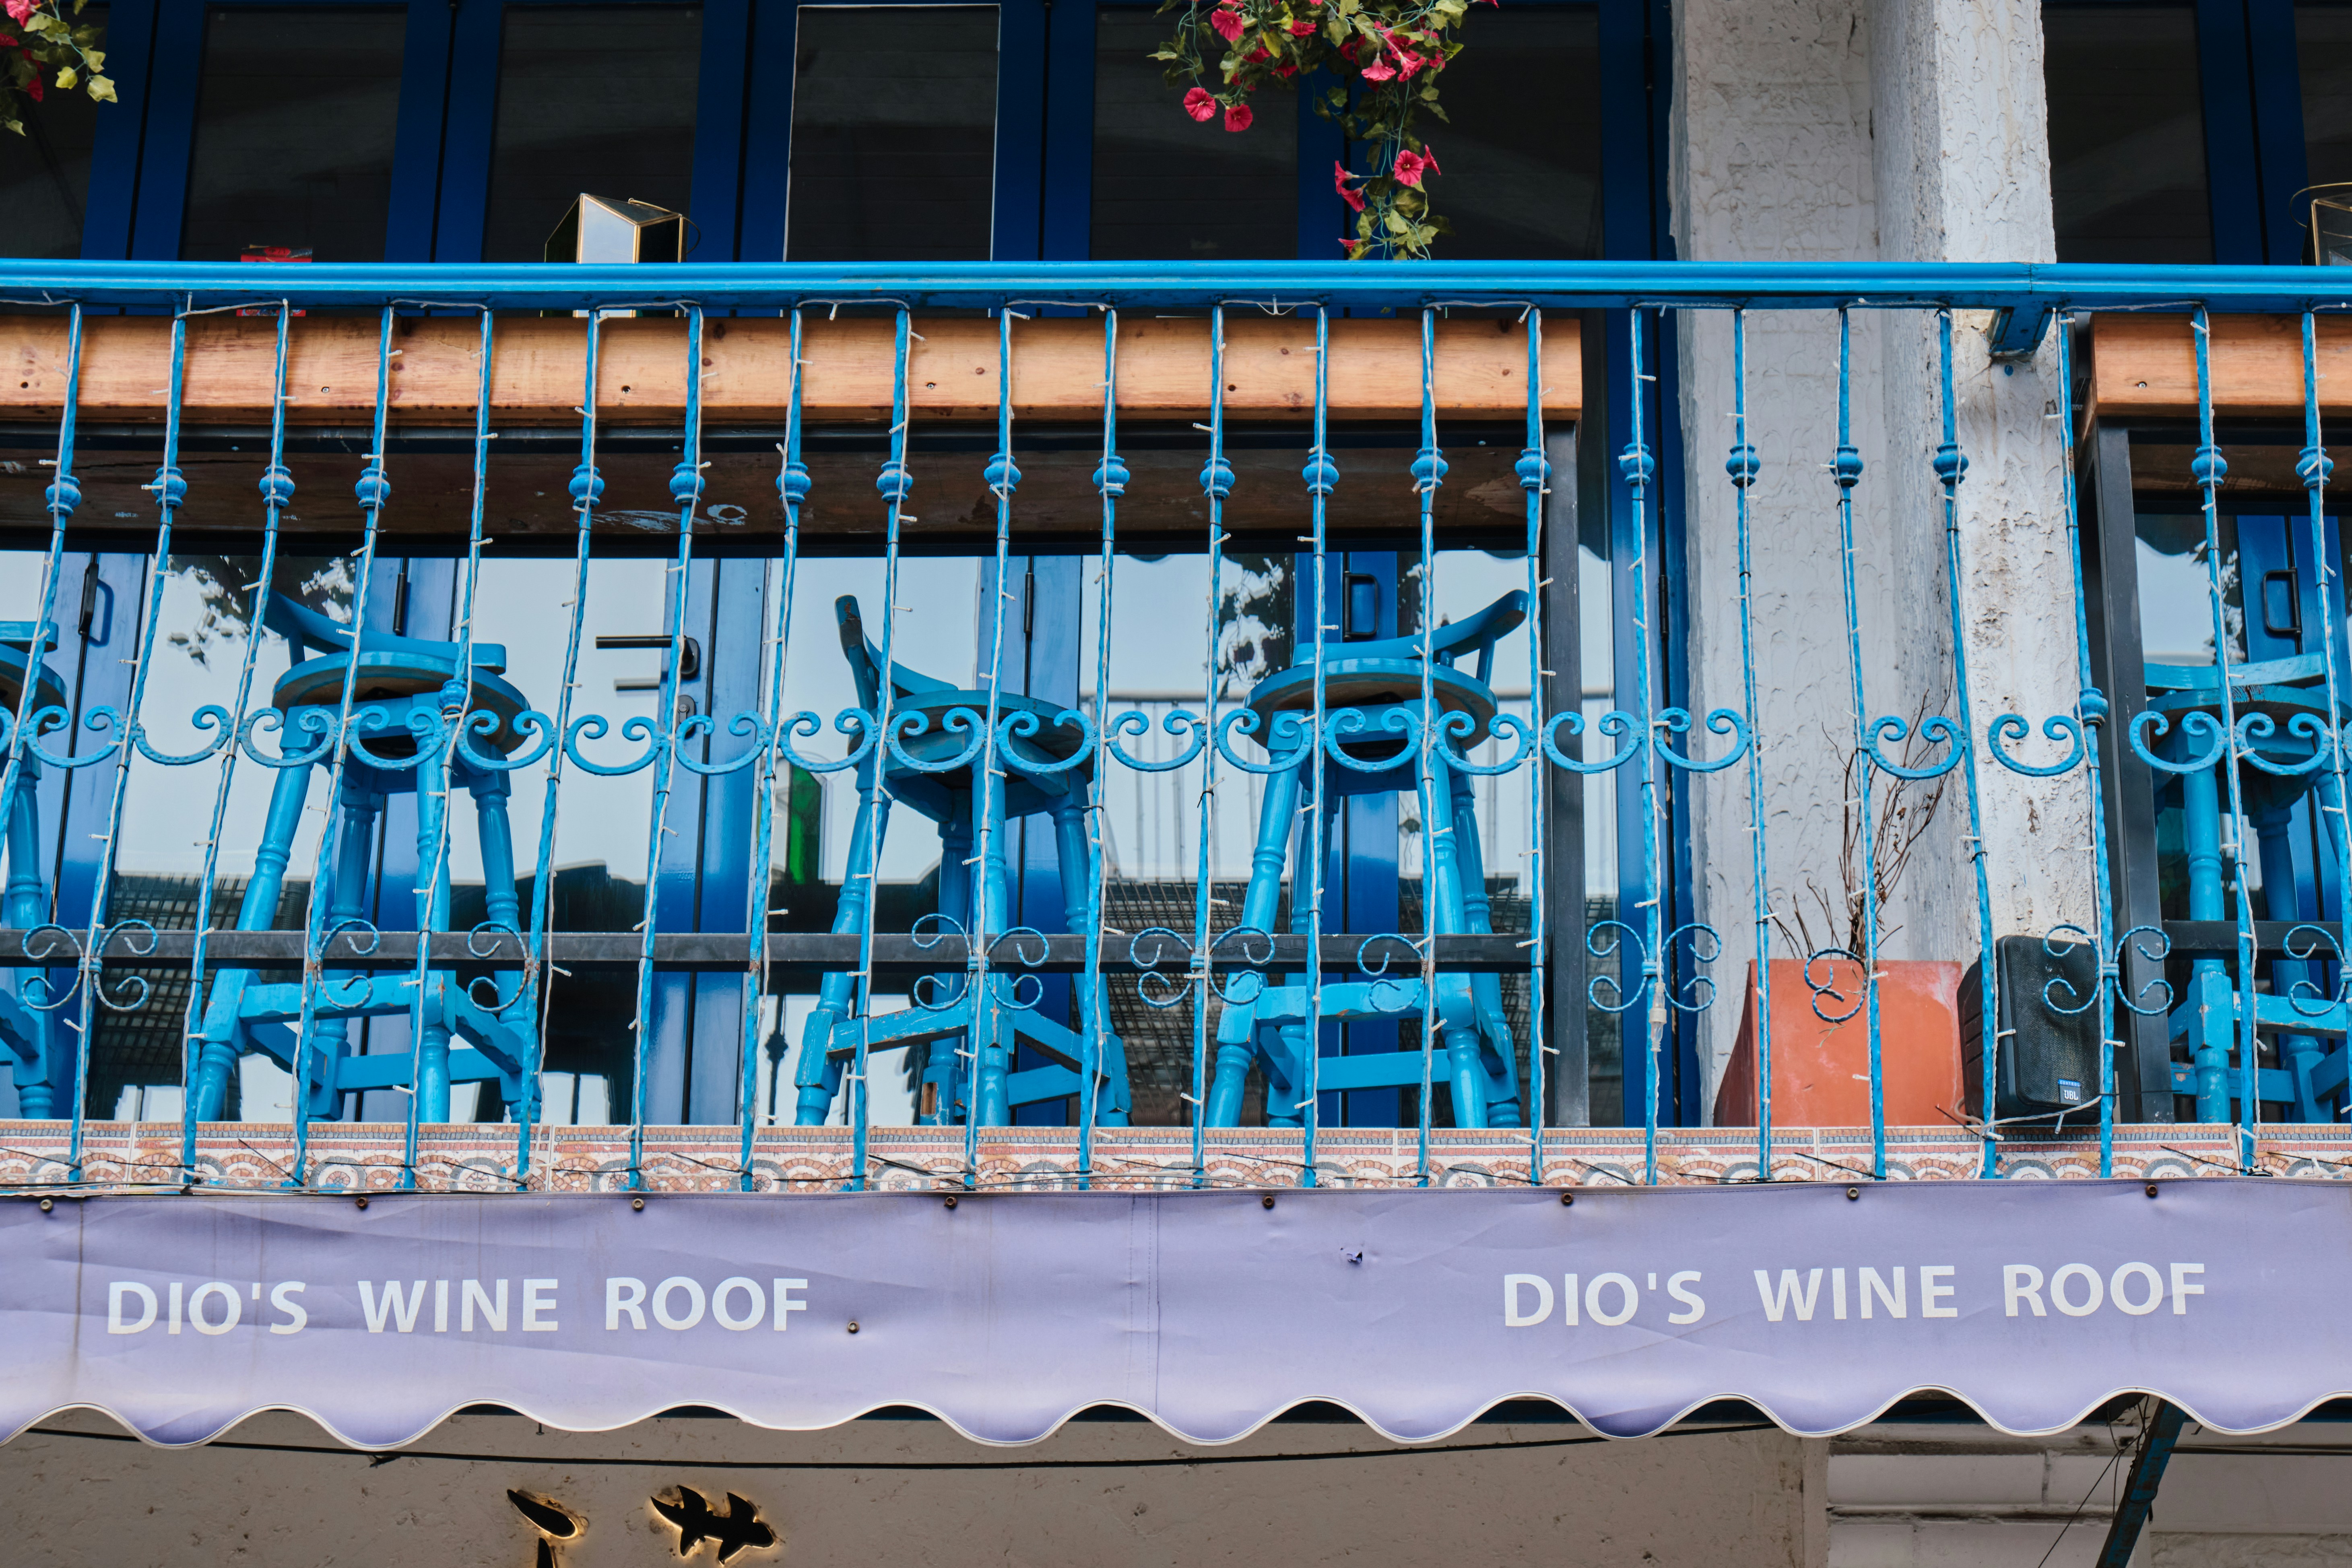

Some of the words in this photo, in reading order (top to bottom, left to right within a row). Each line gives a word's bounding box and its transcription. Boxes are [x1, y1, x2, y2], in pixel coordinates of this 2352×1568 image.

[2064, 1089, 2079, 1100] JBL
[107, 1281, 307, 1335] DIO'S
[357, 1279, 559, 1333] WINE
[605, 1276, 808, 1331] ROOF
[1504, 1270, 1705, 1327] DIO'S
[1754, 1266, 1958, 1322] WINE
[2003, 1262, 2205, 1316] ROOF
